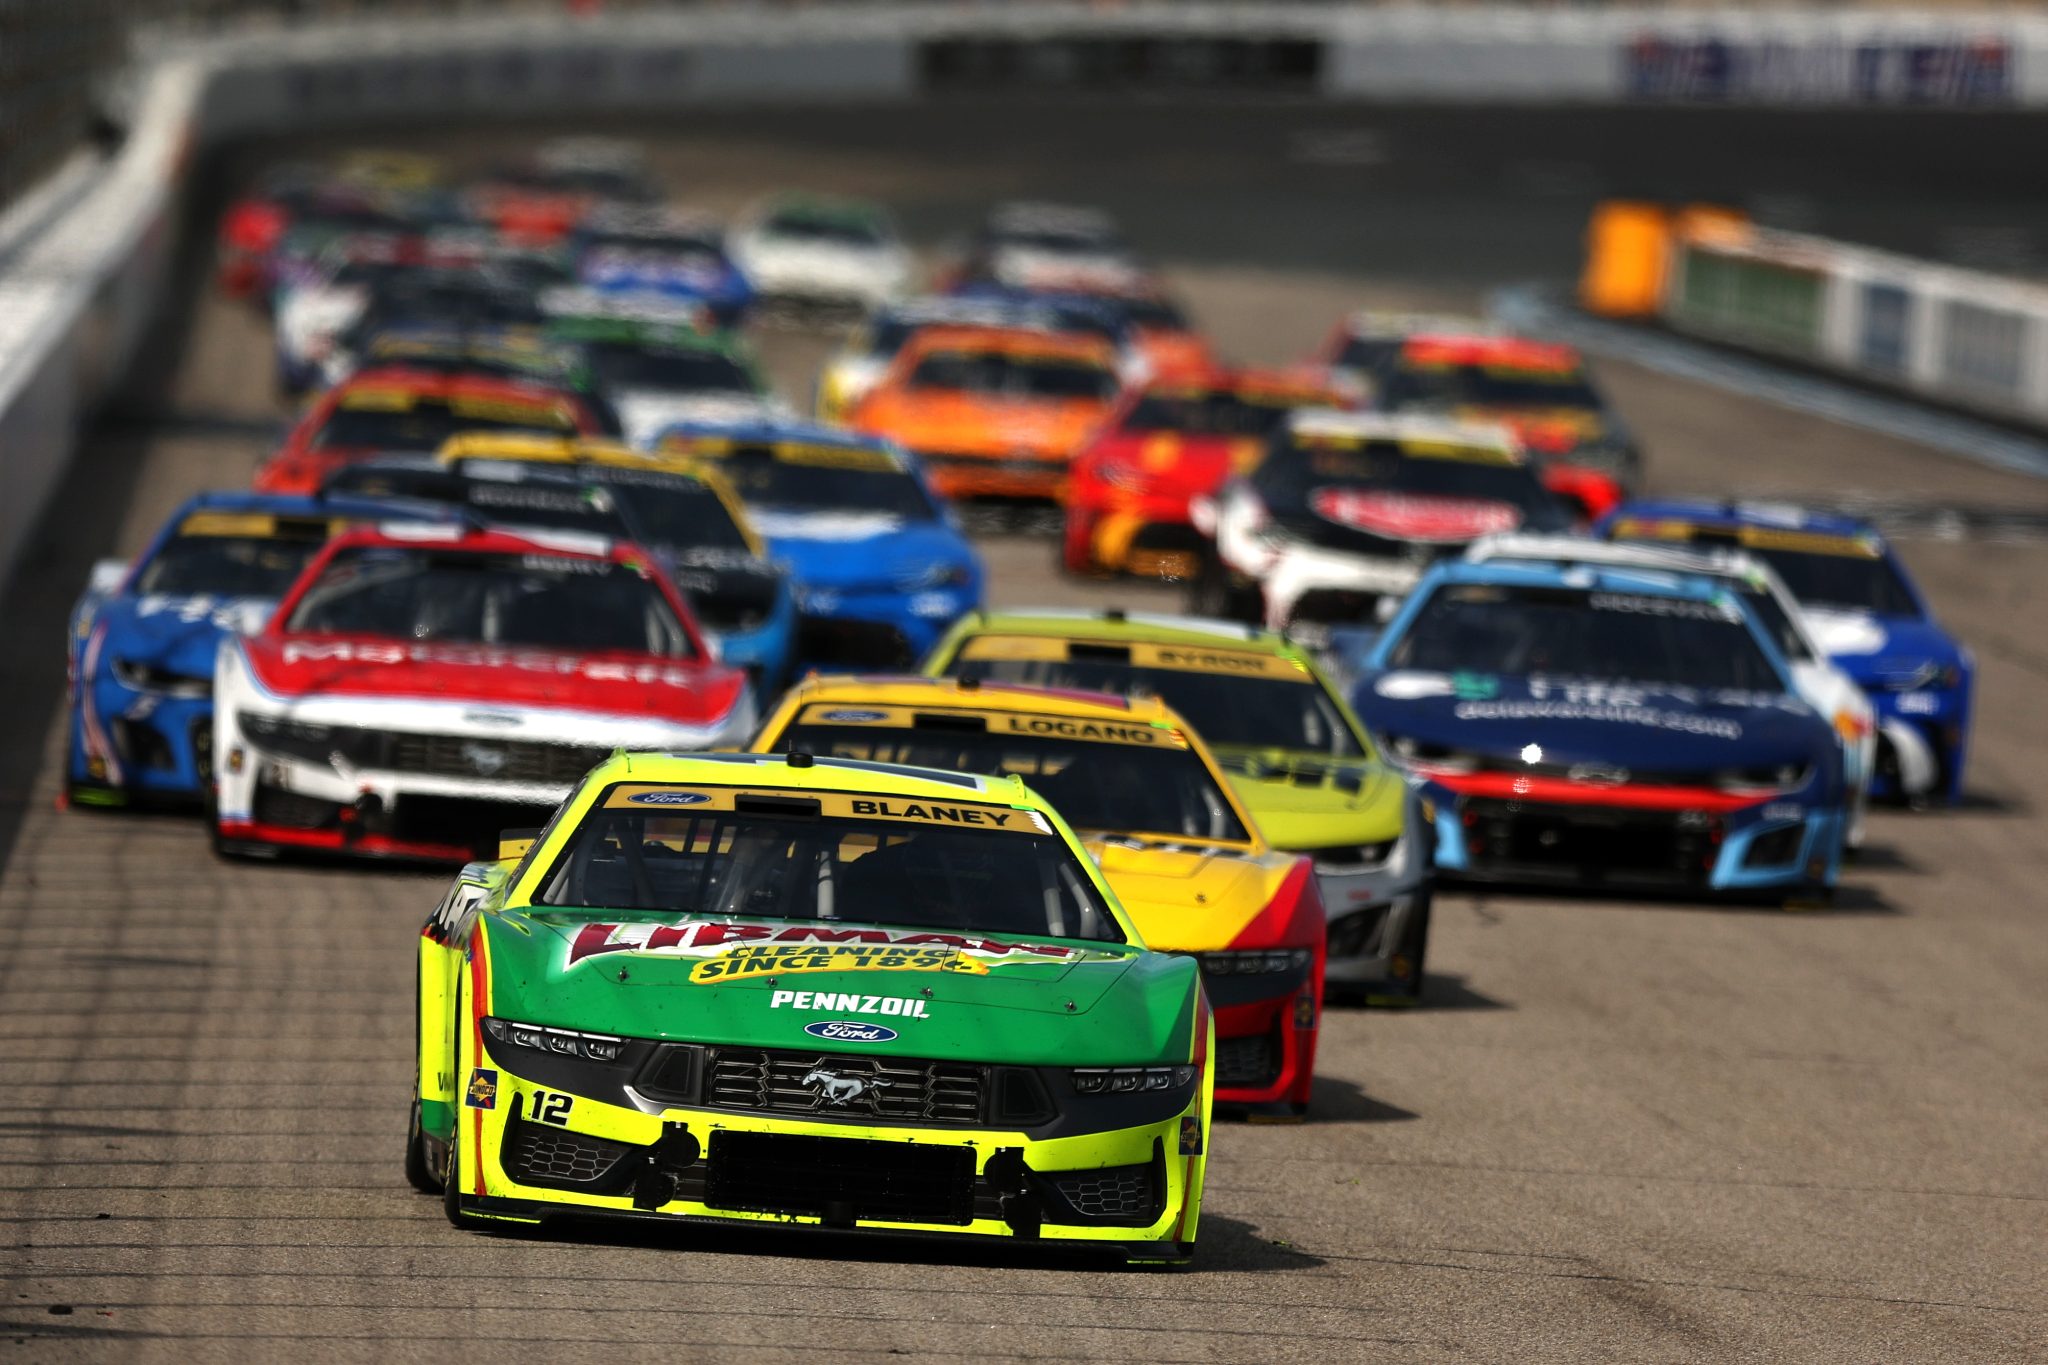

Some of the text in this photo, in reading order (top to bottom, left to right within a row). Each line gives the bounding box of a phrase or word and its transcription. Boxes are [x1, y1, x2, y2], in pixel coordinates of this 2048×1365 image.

[1159, 651, 1265, 671] BYRON
[1009, 718, 1153, 743] LOGANO
[852, 800, 1010, 827] BLANEY
[726, 945, 956, 959] CLEANING
[699, 955, 832, 979] SINCE
[770, 990, 931, 1019] PENNZOIL
[531, 1091, 572, 1126] 12
